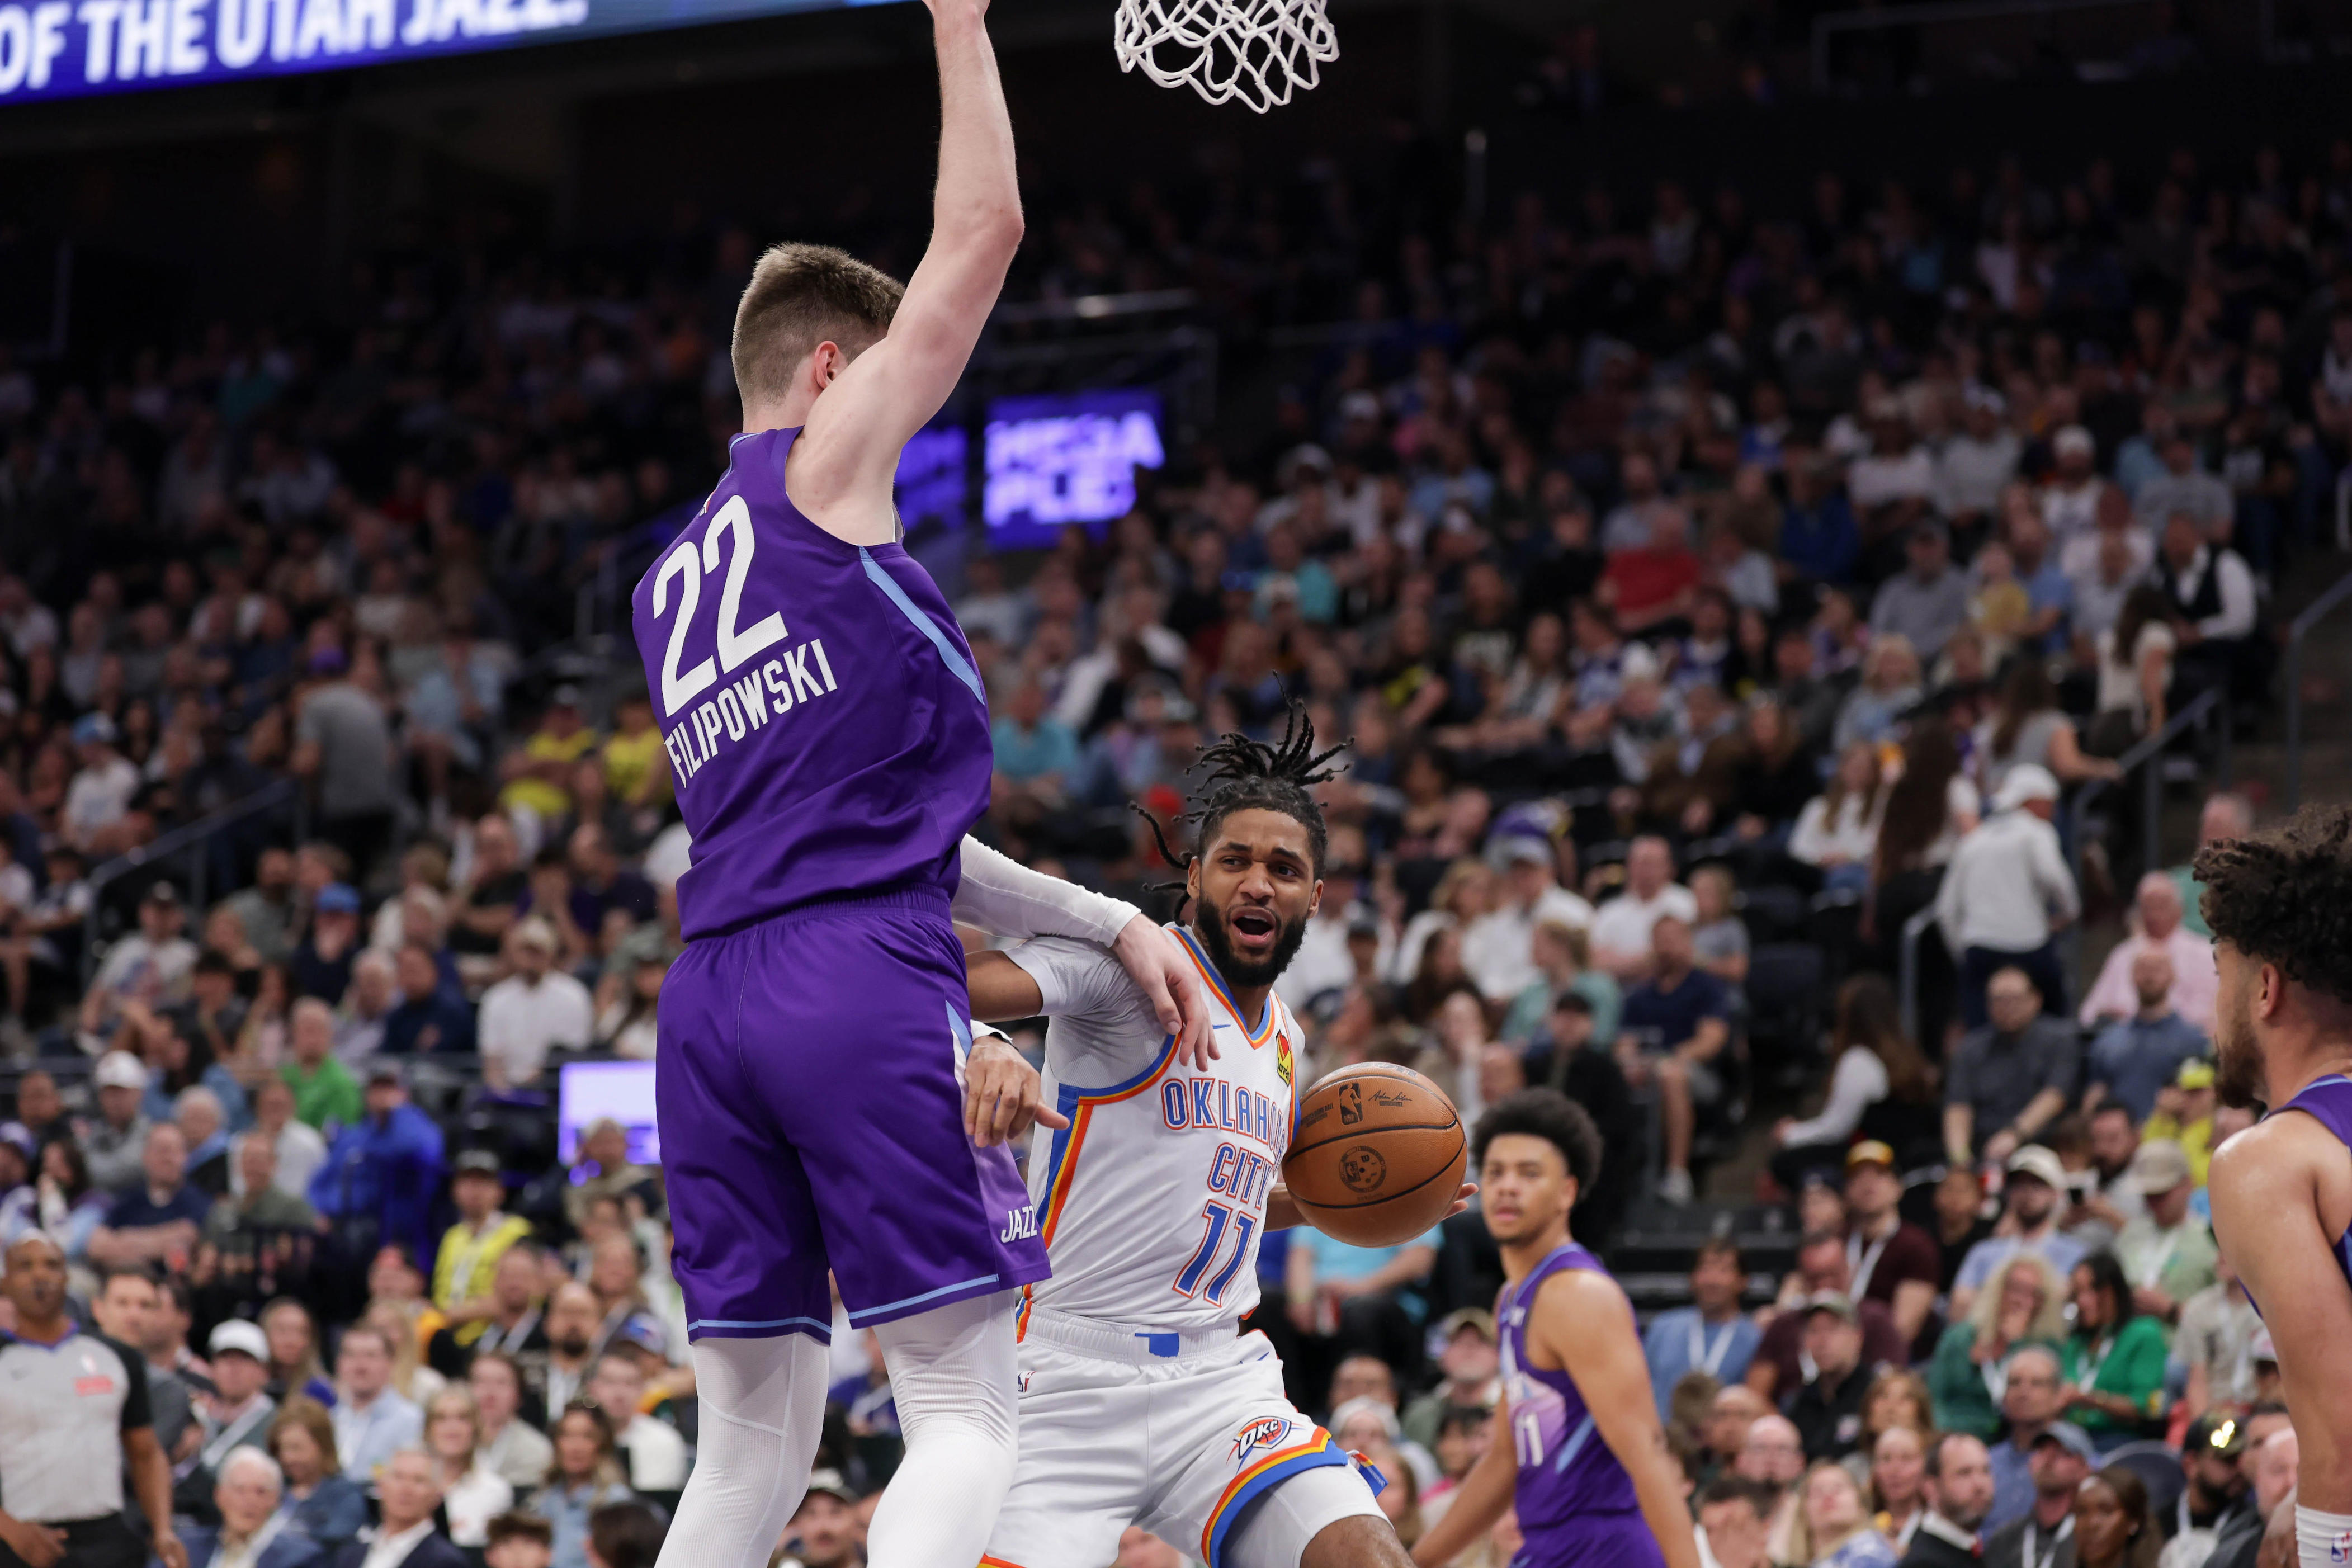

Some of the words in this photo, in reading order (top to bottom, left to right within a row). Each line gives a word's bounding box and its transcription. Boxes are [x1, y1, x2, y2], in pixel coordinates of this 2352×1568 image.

[0, 4, 72, 94] OF
[76, 0, 208, 83] THE
[215, 0, 394, 68] UTAH
[653, 495, 788, 717] 22
[664, 639, 838, 788] FILIPOWSKI
[1207, 1142, 1274, 1210] CITY
[1000, 1205, 1037, 1243] JAZZ
[1173, 1199, 1257, 1307] 11
[1238, 1419, 1279, 1459] OKC
